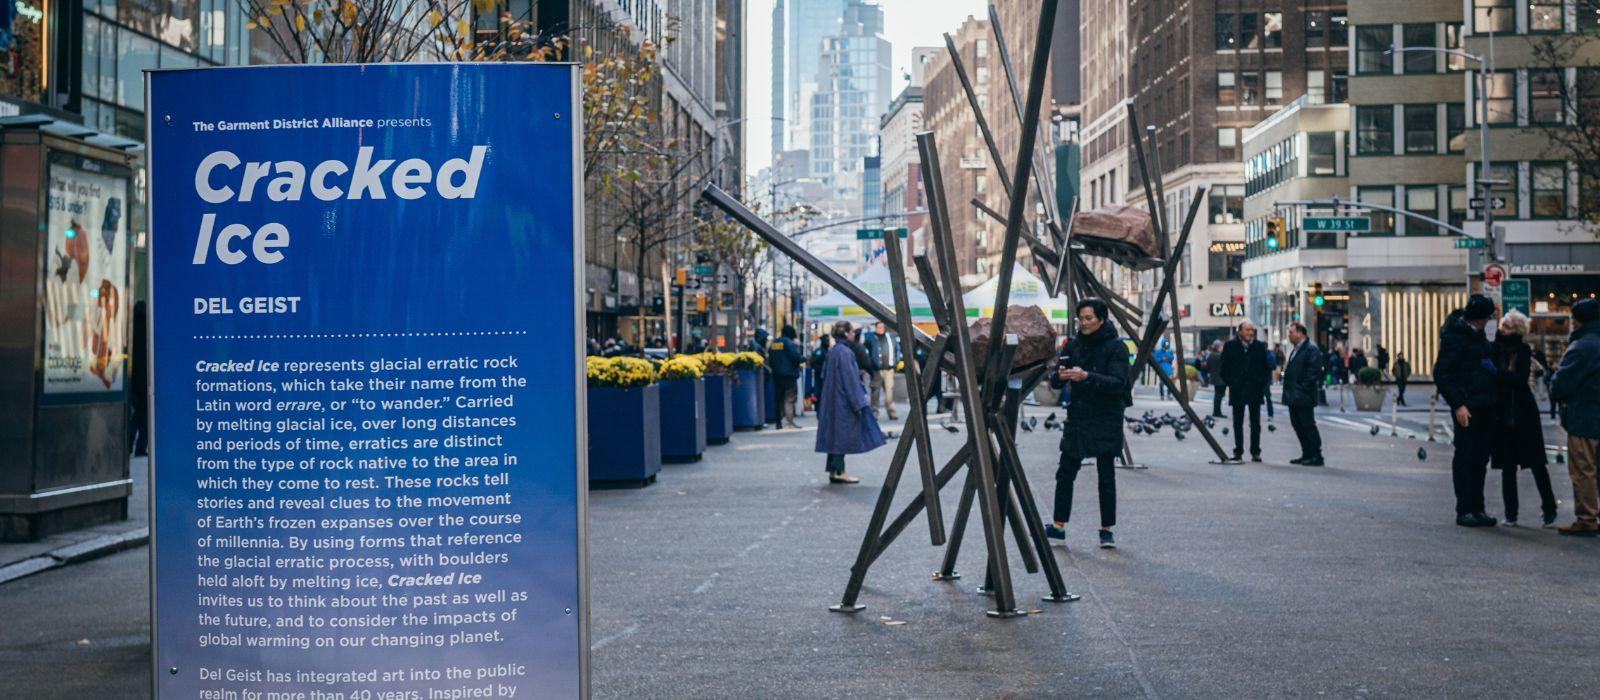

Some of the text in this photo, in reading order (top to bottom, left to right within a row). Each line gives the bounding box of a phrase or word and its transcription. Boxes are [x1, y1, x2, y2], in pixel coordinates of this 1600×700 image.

[193, 117, 431, 131] The Garment District Alliance presents
[194, 146, 487, 204] Cracked
[1317, 220, 1354, 229] W 39 St
[192, 213, 290, 265] Ice
[194, 296, 300, 314] DEL GEIST
[1212, 303, 1244, 316] CAVA
[196, 355, 518, 374] Cracked Ice represents glacial erratic rock
[196, 375, 526, 393] formations, which take their name from the
[197, 399, 230, 411] Latin
[235, 399, 272, 411] word
[276, 401, 325, 412] errare,
[330, 401, 346, 410] or
[456, 394, 513, 408] Carried
[197, 416, 516, 433] by melting glacial ice, over long distances
[197, 434, 502, 452] and periods of time, erratics are distinct
[197, 453, 517, 472] from the type of rock native to the area in
[197, 472, 508, 491] which they come to rest. These rocks tell
[197, 492, 511, 509] stories and reveal clues to the movement
[197, 515, 212, 528] of
[268, 516, 316, 528] frozen
[321, 518, 393, 531] expanses
[399, 517, 433, 527] over
[438, 514, 464, 526] the
[470, 514, 521, 525] course
[198, 532, 522, 550] of millennia. By using forms that reference
[198, 552, 508, 570] the glacial erratic process, with boulders
[198, 572, 482, 590] held aloft by melting ice, Cracked Ice
[198, 590, 528, 608] invites us to think about the past as well as
[199, 608, 517, 628] the future, and to consider the impacts of
[199, 630, 503, 649] global warming on our changing planet.
[200, 664, 525, 684] Del Geist has integrated art into the public
[200, 688, 237, 700] realm
[242, 688, 262, 700] for
[310, 690, 344, 700] than
[350, 690, 371, 700] 40
[377, 691, 422, 700] years.
[430, 684, 492, 700] Inspired
[499, 684, 516, 697] by
